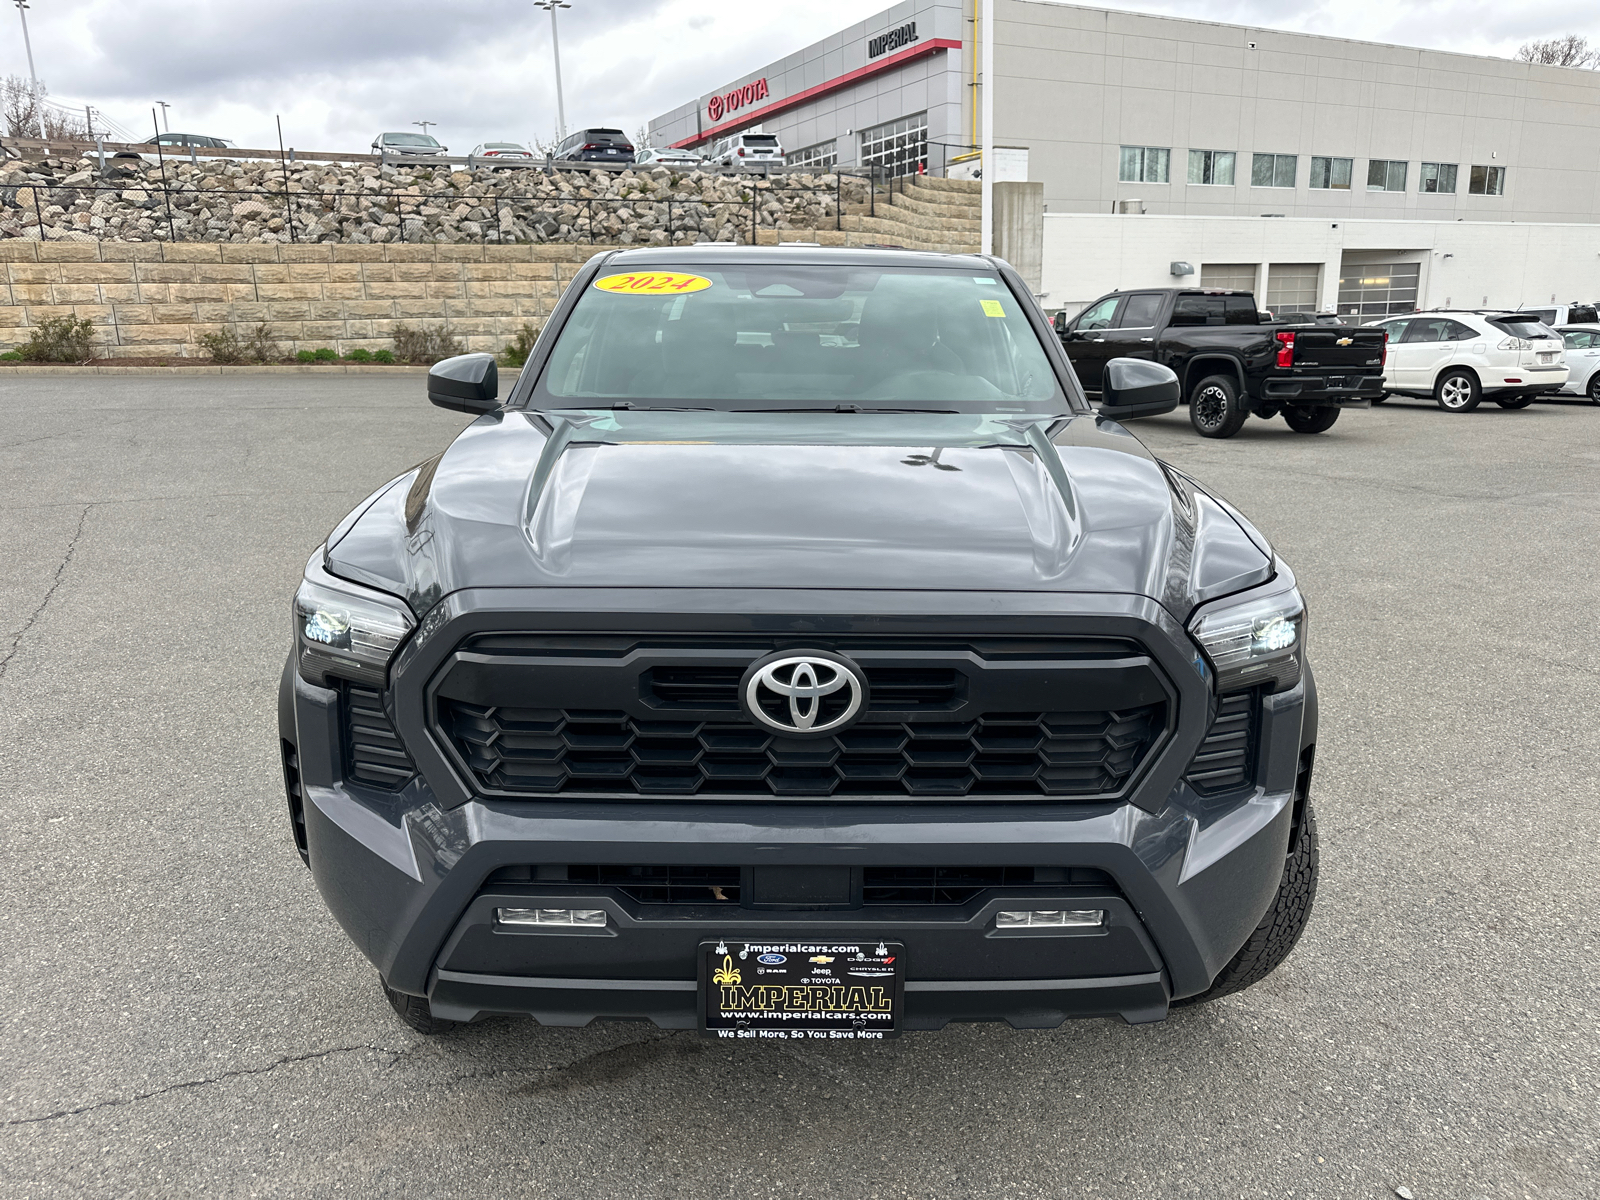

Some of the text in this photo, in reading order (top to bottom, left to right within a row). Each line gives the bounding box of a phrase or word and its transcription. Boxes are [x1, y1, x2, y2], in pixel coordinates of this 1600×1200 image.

[868, 21, 919, 59] IMPERIAL
[723, 77, 769, 113] TOYOTA
[608, 276, 697, 290] 2024
[744, 943, 860, 954] Imperialcars.com
[811, 967, 831, 976] Jeep
[720, 985, 892, 1012] IMPERIAL
[720, 1010, 892, 1021] www.imperialcars.com
[718, 1030, 734, 1038] We
[737, 1030, 756, 1038] Sell
[759, 1030, 788, 1039] More,
[791, 1030, 804, 1038] So
[807, 1031, 827, 1039] You
